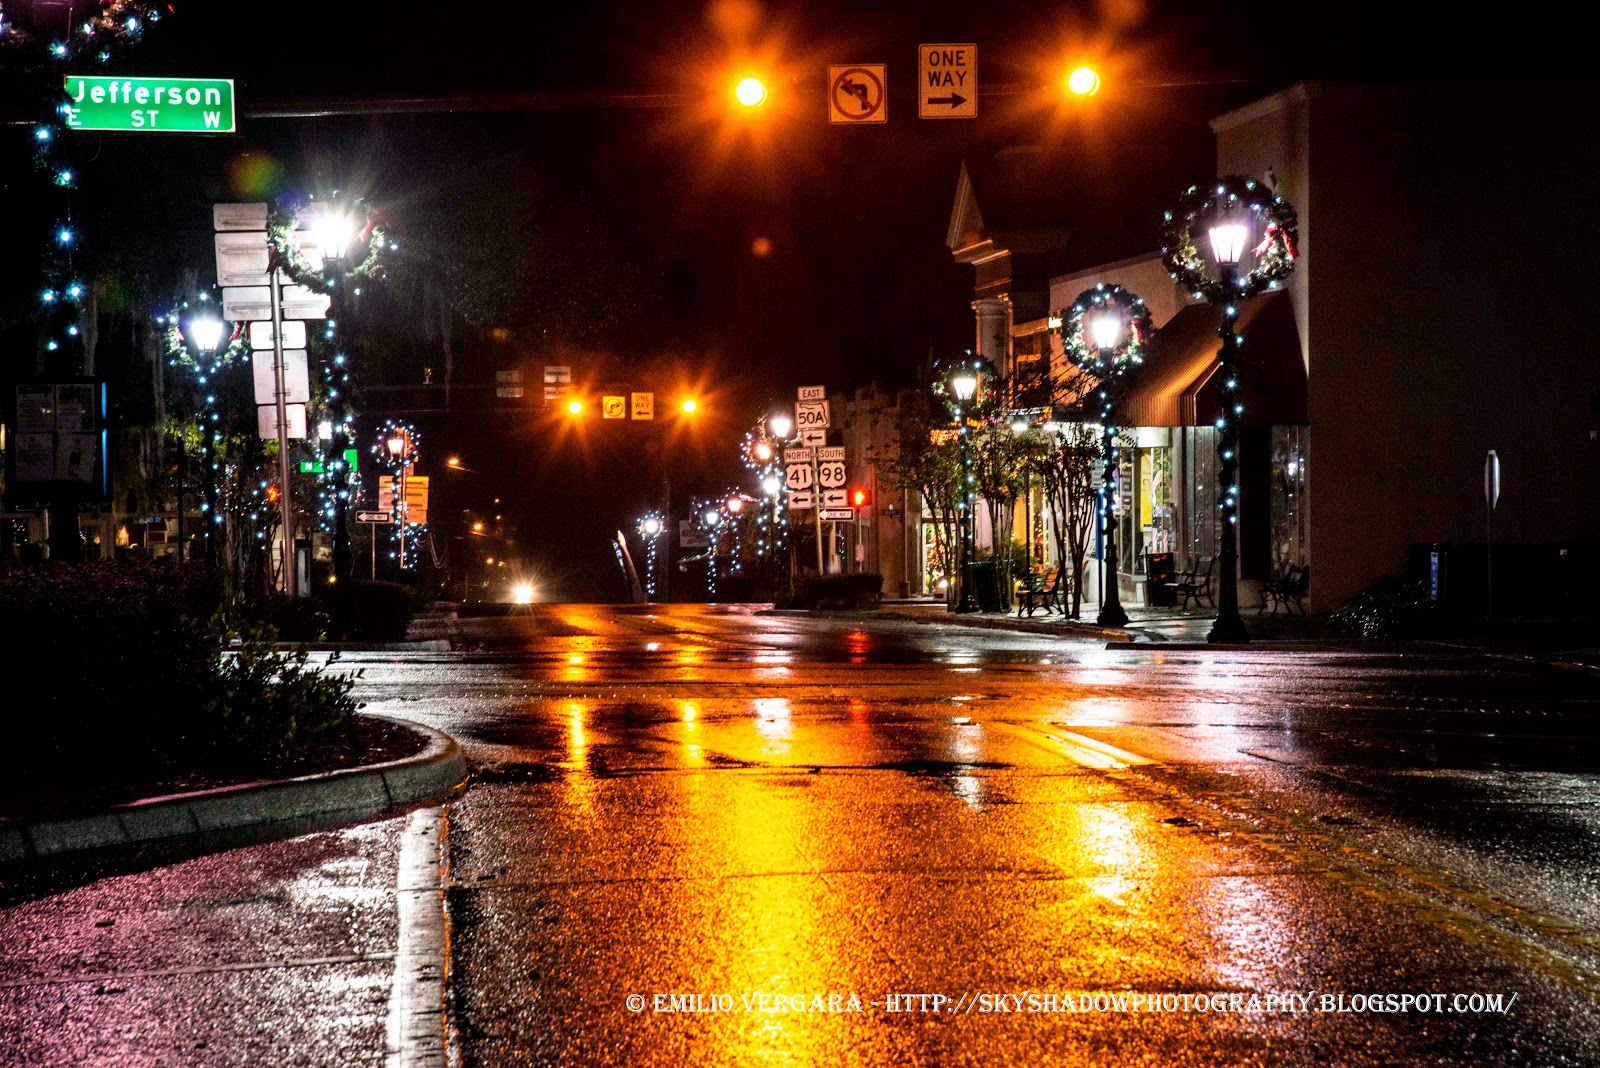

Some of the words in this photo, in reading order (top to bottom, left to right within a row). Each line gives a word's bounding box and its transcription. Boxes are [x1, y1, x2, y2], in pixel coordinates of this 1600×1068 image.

[929, 50, 966, 67] ONE
[928, 70, 967, 87] WAY
[72, 80, 221, 105] Jefferson
[68, 108, 82, 126] E
[131, 109, 160, 128] ST
[203, 111, 221, 129] W
[802, 389, 820, 398] EAST
[798, 412, 824, 424] 50A
[785, 450, 810, 460] NORTH
[819, 449, 844, 459] SOUTH
[789, 468, 807, 484] 41
[821, 466, 844, 482] 98
